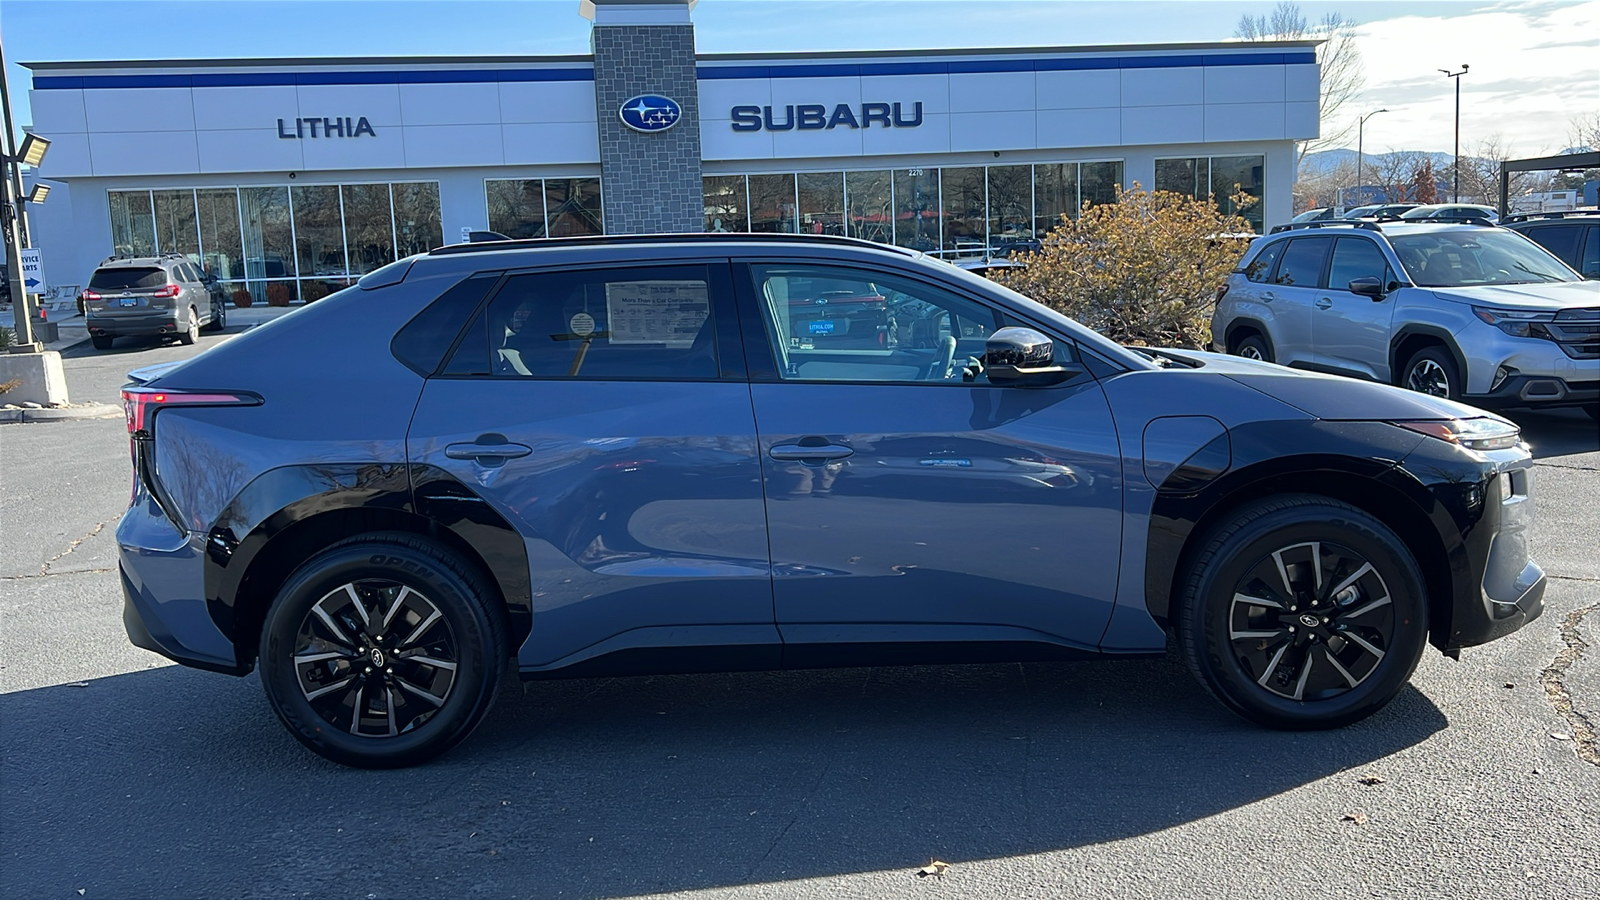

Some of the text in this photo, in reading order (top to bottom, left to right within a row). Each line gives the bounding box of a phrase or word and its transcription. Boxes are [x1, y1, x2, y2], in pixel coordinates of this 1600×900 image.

[277, 117, 376, 139] LITHIA
[731, 102, 923, 132] SUBARU
[369, 555, 435, 579] OPEN
